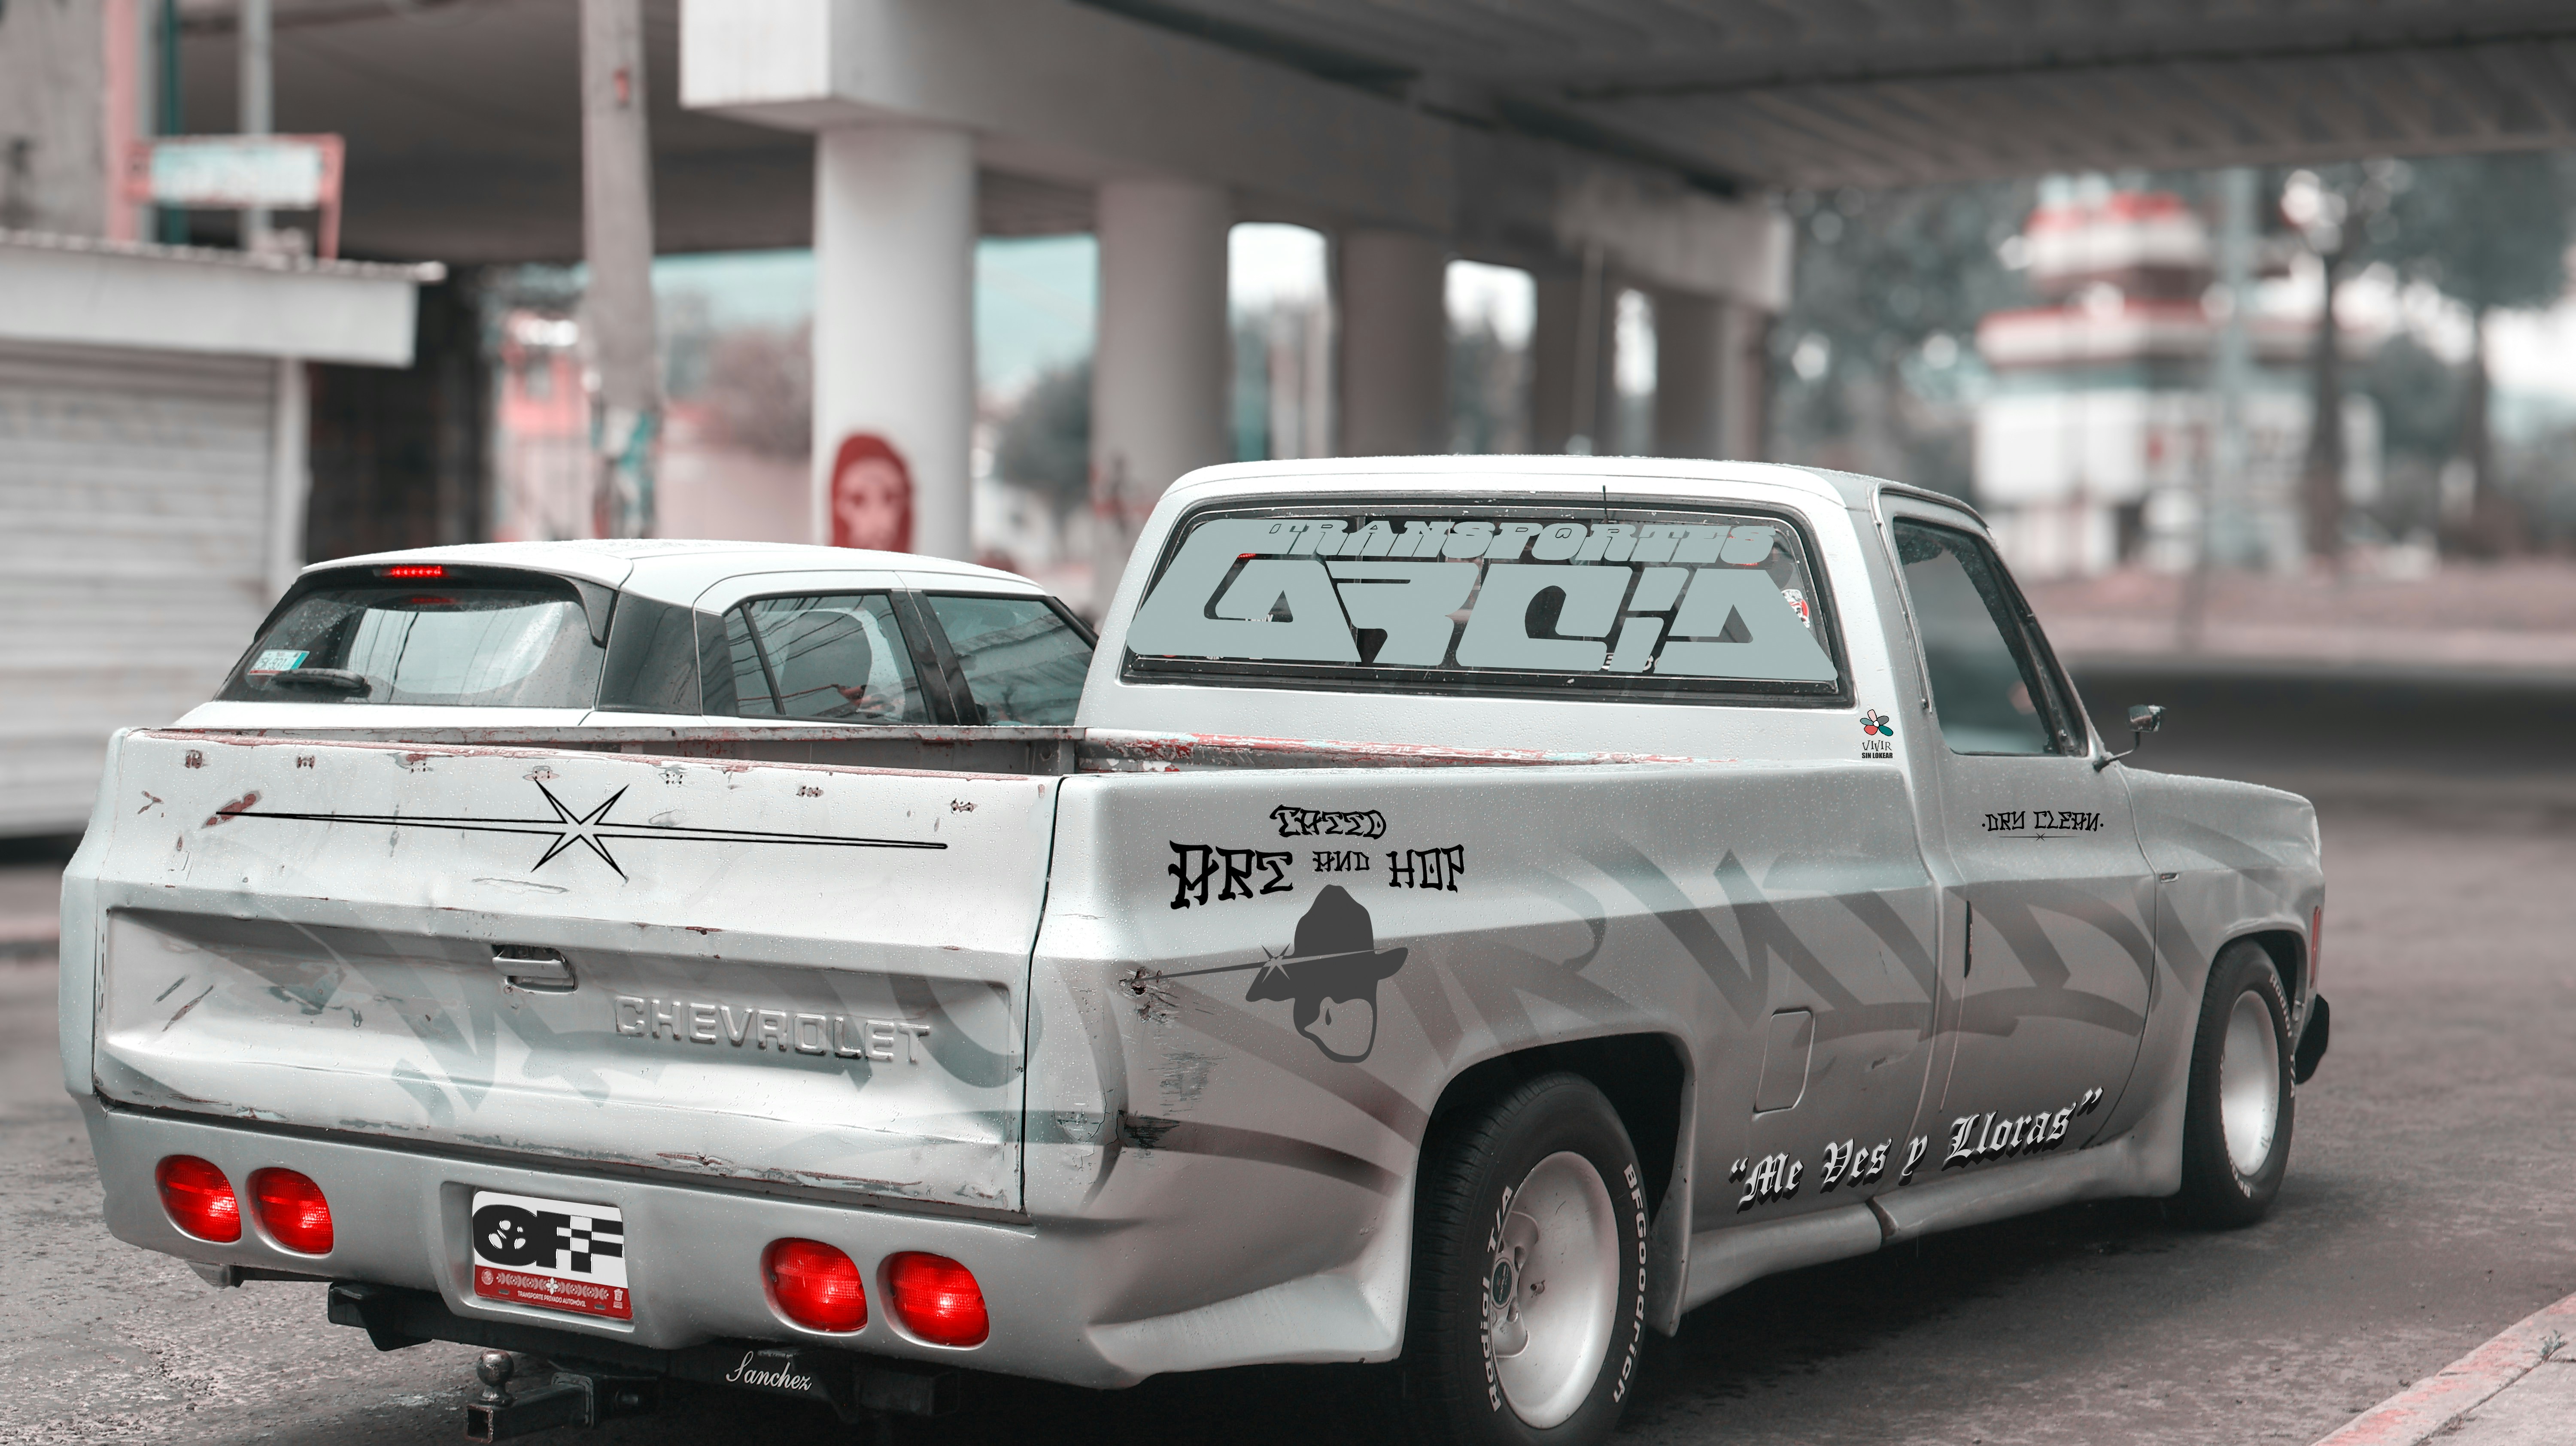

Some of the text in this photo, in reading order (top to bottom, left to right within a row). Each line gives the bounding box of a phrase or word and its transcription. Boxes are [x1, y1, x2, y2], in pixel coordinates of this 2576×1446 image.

[1260, 519, 1776, 564] TRANSPORTES
[1862, 740, 1893, 751] VIVIR
[1312, 851, 1370, 872] AND
[1385, 844, 1464, 893] HOP
[614, 995, 931, 1065] CHEVROLET
[1820, 1137, 1893, 1194] Ves
[1898, 1134, 1929, 1186] y
[1487, 1185, 1513, 1253] T/A
[517, 1290, 587, 1308] TRANSPORTE PRIVADO AUTOMÓVIL
[1613, 1163, 1646, 1403] BFGoodrich
[726, 1351, 812, 1391] Sanchez
[1480, 1277, 1501, 1412] Radial
